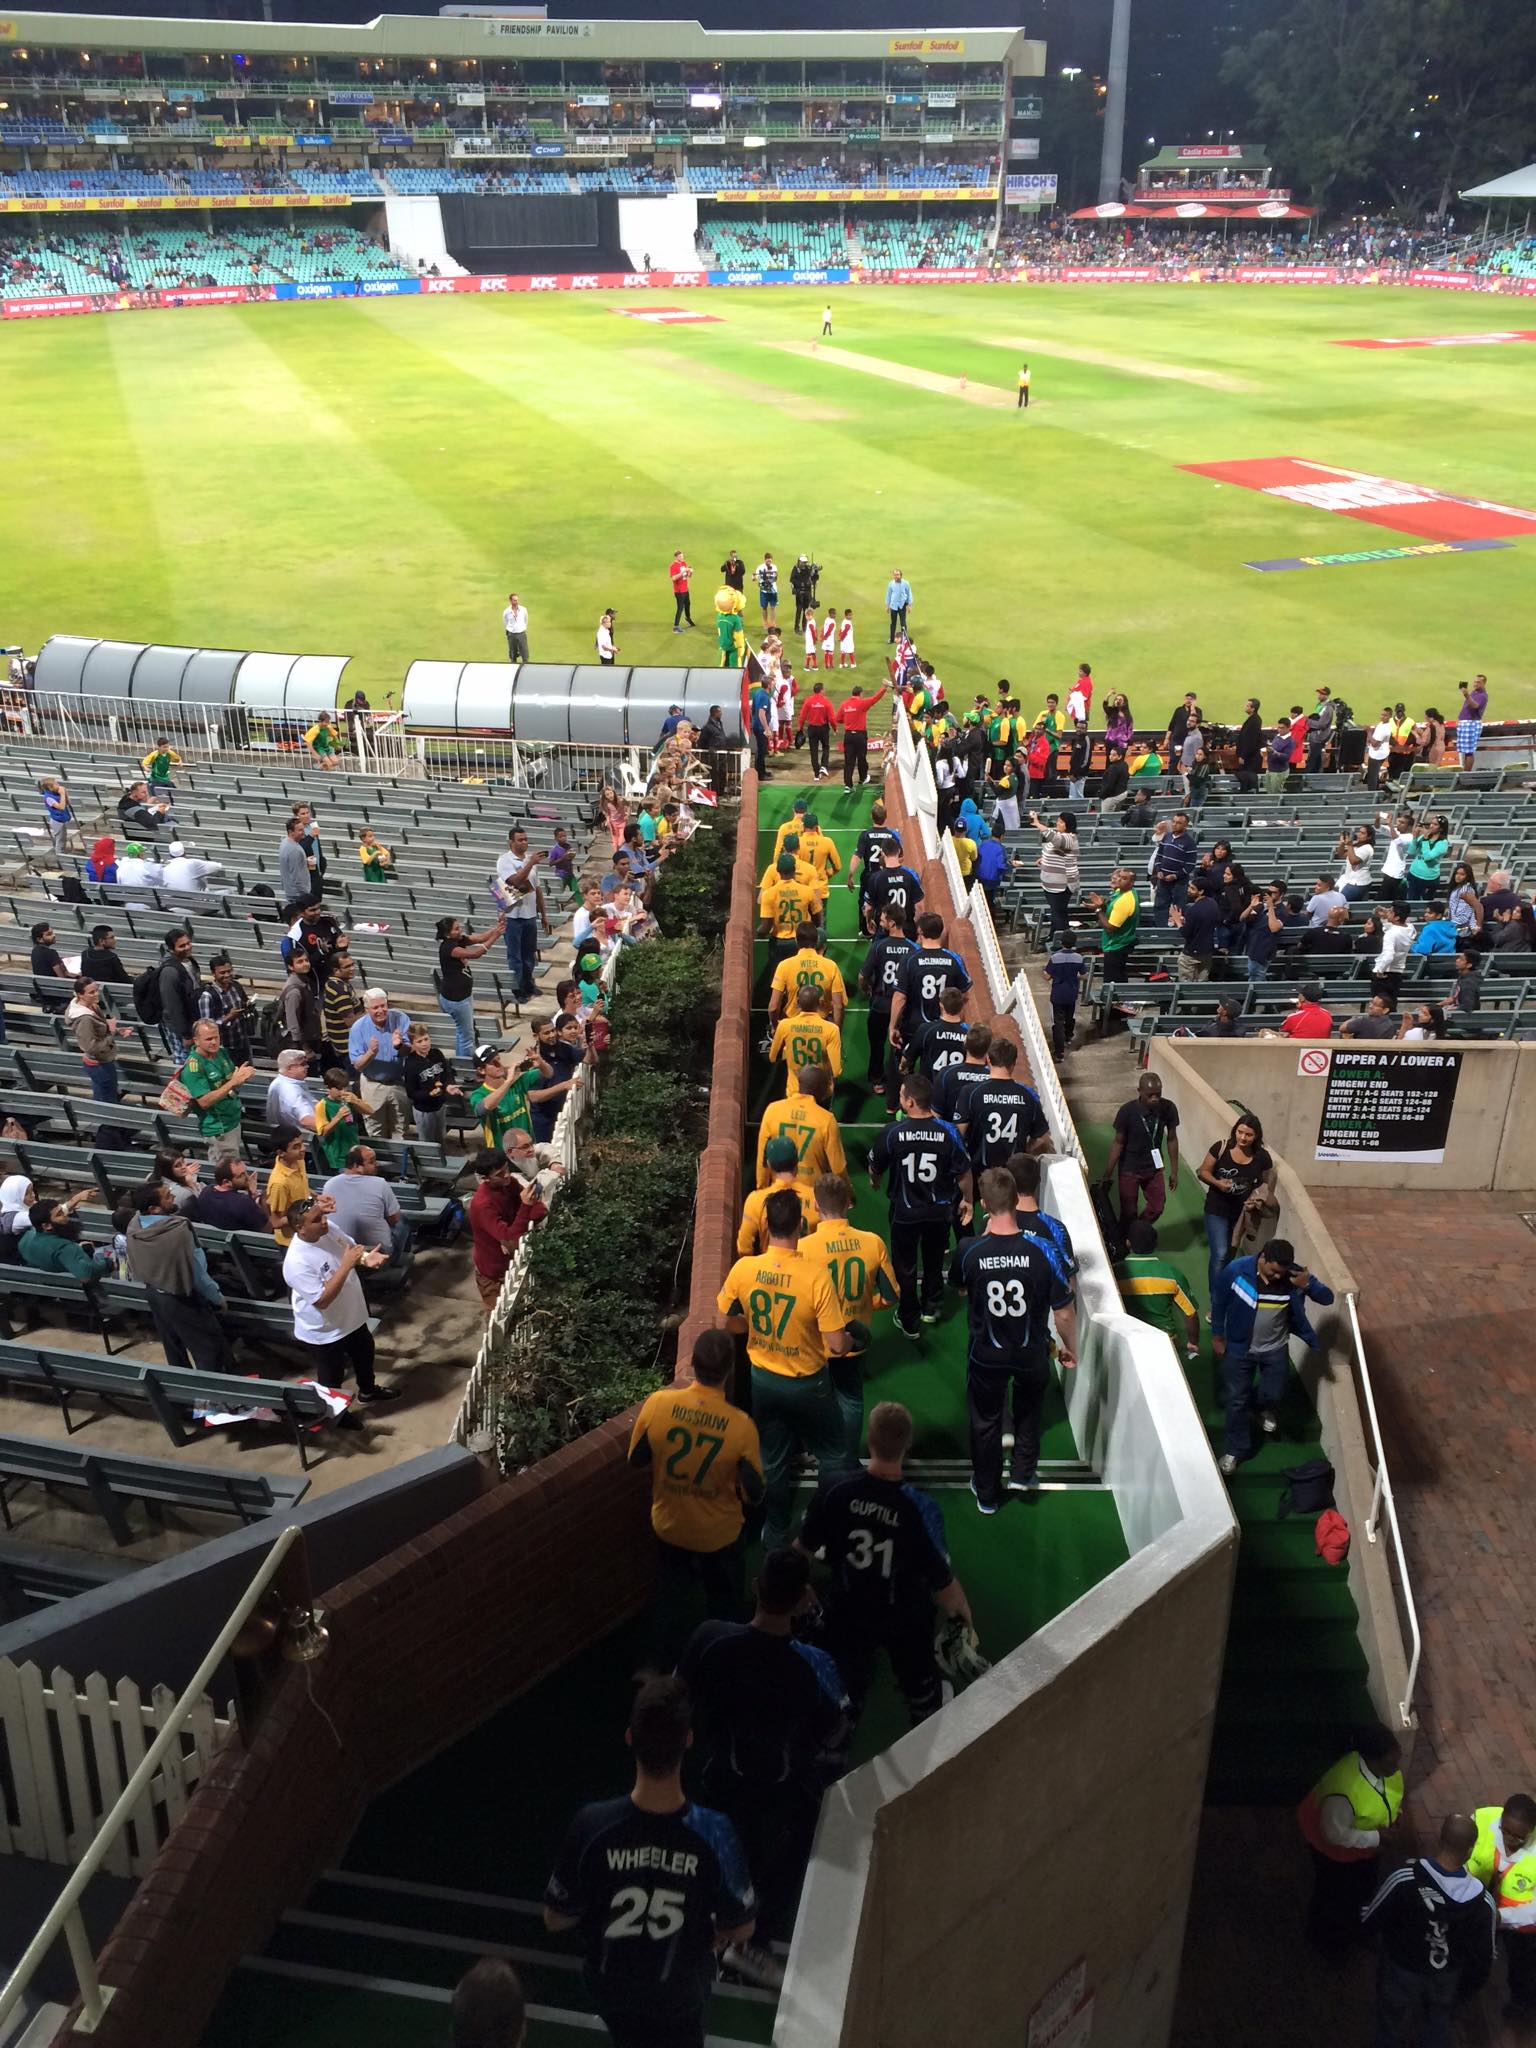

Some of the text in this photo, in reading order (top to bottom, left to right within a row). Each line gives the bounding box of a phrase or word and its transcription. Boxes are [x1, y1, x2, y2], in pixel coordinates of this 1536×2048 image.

[500, 24, 579, 35] FRIENDSHIP PAVILION
[894, 40, 923, 50] Sunfoil
[930, 40, 959, 50] Sunfoil
[1006, 175, 1058, 188] HIRSCH'S
[571, 276, 598, 288] KFC
[623, 274, 650, 286] KFC
[672, 273, 700, 286] KFC
[728, 271, 763, 284] oxigen
[792, 270, 828, 283] oxigen
[363, 280, 399, 293] oxigen
[428, 279, 455, 292] KFC
[480, 278, 507, 291] KFC
[530, 277, 557, 290] KFC
[296, 284, 333, 297] oxigen
[869, 845, 880, 863] 2
[888, 888, 907, 908] 20
[778, 899, 802, 924] 25
[886, 946, 910, 954] ELLIOTT
[883, 960, 899, 984] 8
[922, 974, 947, 1000] 81
[792, 1036, 822, 1067] 69
[1335, 1054, 1456, 1067] UPPER A / LOWER A
[1332, 1070, 1384, 1080] LOWER A:
[1331, 1080, 1389, 1089] UMGENI END
[983, 1094, 1026, 1105] BRACEWELL
[1328, 1096, 1353, 1104] ENTRY
[1327, 1104, 1352, 1112] ENTRY
[1326, 1112, 1350, 1120] ENTRY
[986, 1112, 1018, 1144] 34
[1324, 1120, 1376, 1129] LOWER A:
[898, 1130, 945, 1143] N McCULLUM
[1323, 1130, 1359, 1138] UMGENI
[902, 1152, 938, 1183] 15
[826, 1239, 861, 1254] MILLER
[979, 1256, 1030, 1270] NEESHAM
[756, 1270, 793, 1288] ABBOTT
[828, 1256, 866, 1301] 10
[986, 1280, 1027, 1318] 83
[750, 1288, 796, 1340] 87
[671, 1402, 730, 1432] ROSSOUW
[666, 1425, 725, 1488] 27
[850, 1498, 900, 1528] GUPTILL
[846, 1528, 893, 1578] 31
[606, 1846, 699, 1878] WHEELER
[604, 1886, 686, 1940] 25
